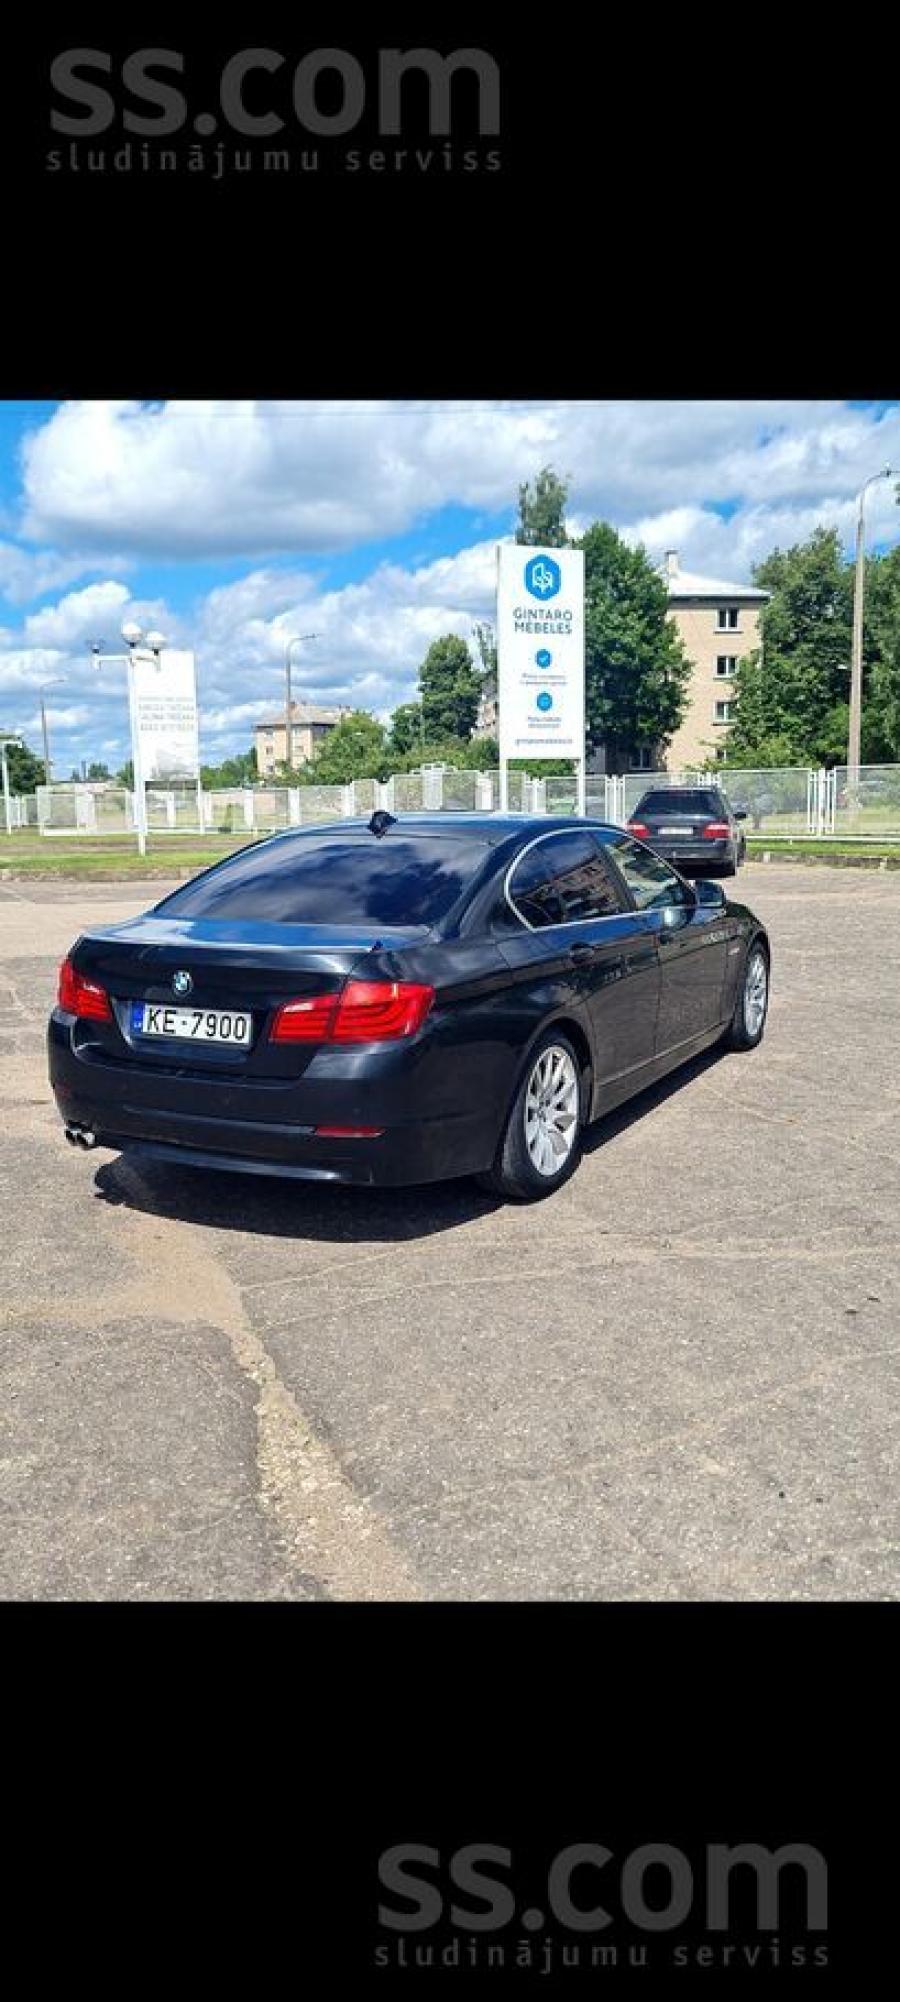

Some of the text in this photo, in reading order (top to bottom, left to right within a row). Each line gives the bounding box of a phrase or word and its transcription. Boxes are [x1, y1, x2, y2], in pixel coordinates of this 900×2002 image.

[512, 607, 573, 621] GINTARO
[514, 621, 573, 634] MEBELES
[147, 1007, 247, 1041] KE-7900
